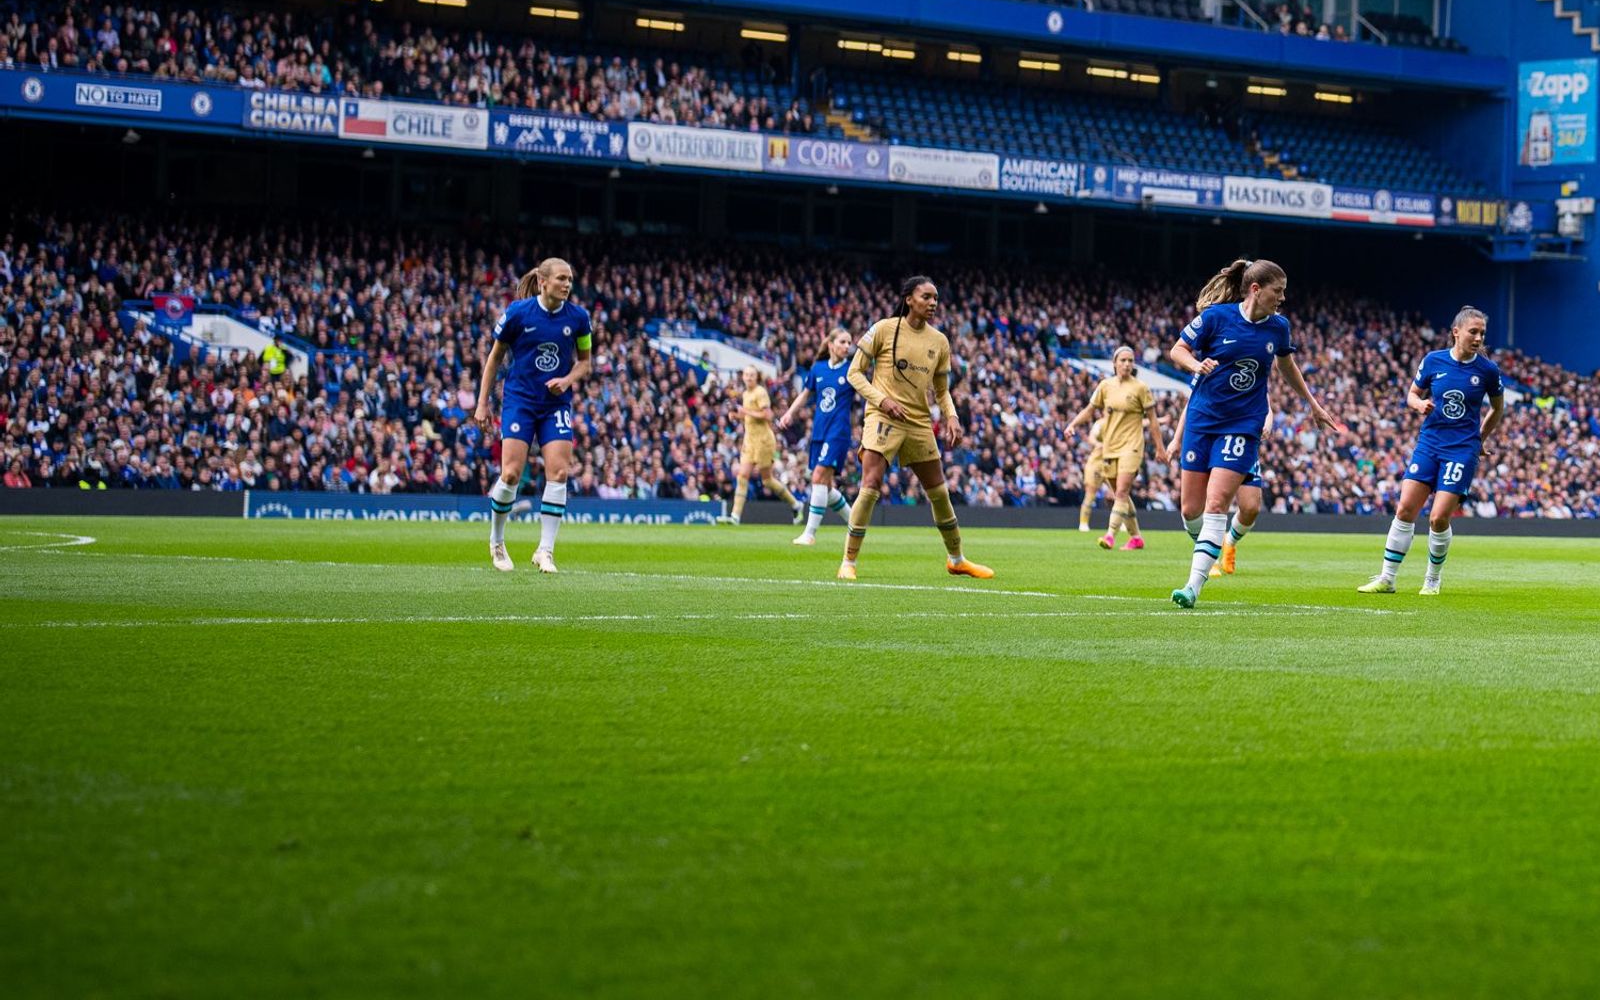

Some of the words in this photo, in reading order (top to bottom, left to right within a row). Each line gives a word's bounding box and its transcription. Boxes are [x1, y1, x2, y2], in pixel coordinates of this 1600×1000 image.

[78, 87, 105, 102] NO
[1529, 71, 1588, 103] Zapp
[250, 91, 337, 115] CHELSEA
[250, 109, 335, 132] CROATIA
[393, 114, 453, 137] CHILE
[797, 140, 853, 168] CORK
[1002, 158, 1077, 179] AMERICAN
[1002, 175, 1077, 196] SOUTHWEST
[1229, 186, 1305, 207] HASTINGS
[1222, 434, 1246, 457] 18
[1443, 461, 1465, 483] 15
